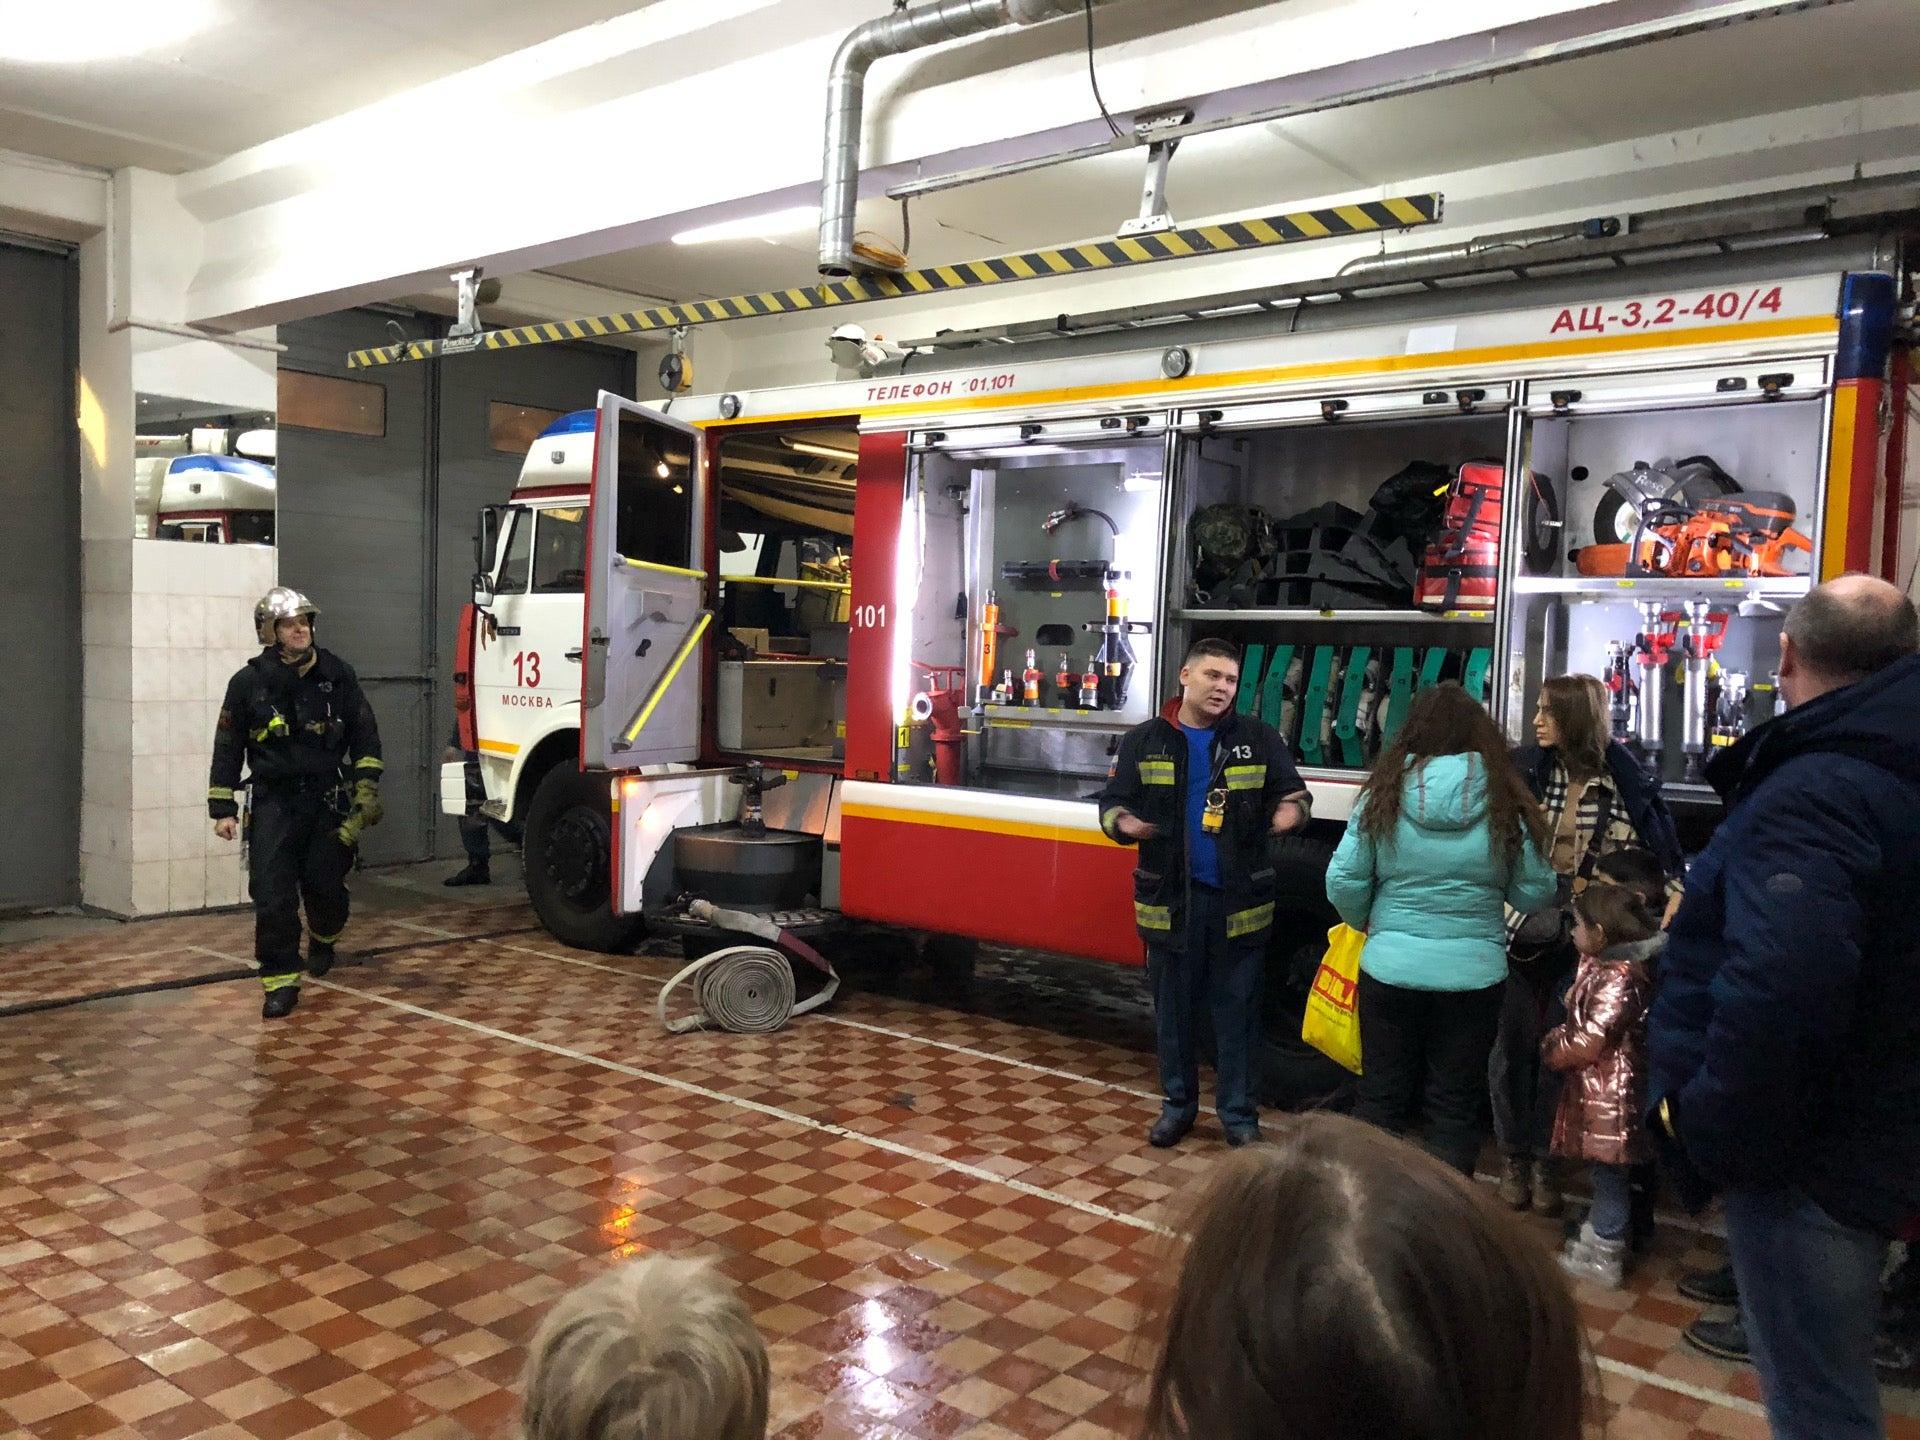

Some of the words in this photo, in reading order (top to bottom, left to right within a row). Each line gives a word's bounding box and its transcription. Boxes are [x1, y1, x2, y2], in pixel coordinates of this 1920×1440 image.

[1550, 287, 1783, 333] АЦ-3,2-40/4
[867, 380, 953, 401] ТЕЛЕФОН
[512, 651, 541, 688] 13
[502, 694, 553, 709] МОСКВА
[1232, 745, 1252, 759] 13
